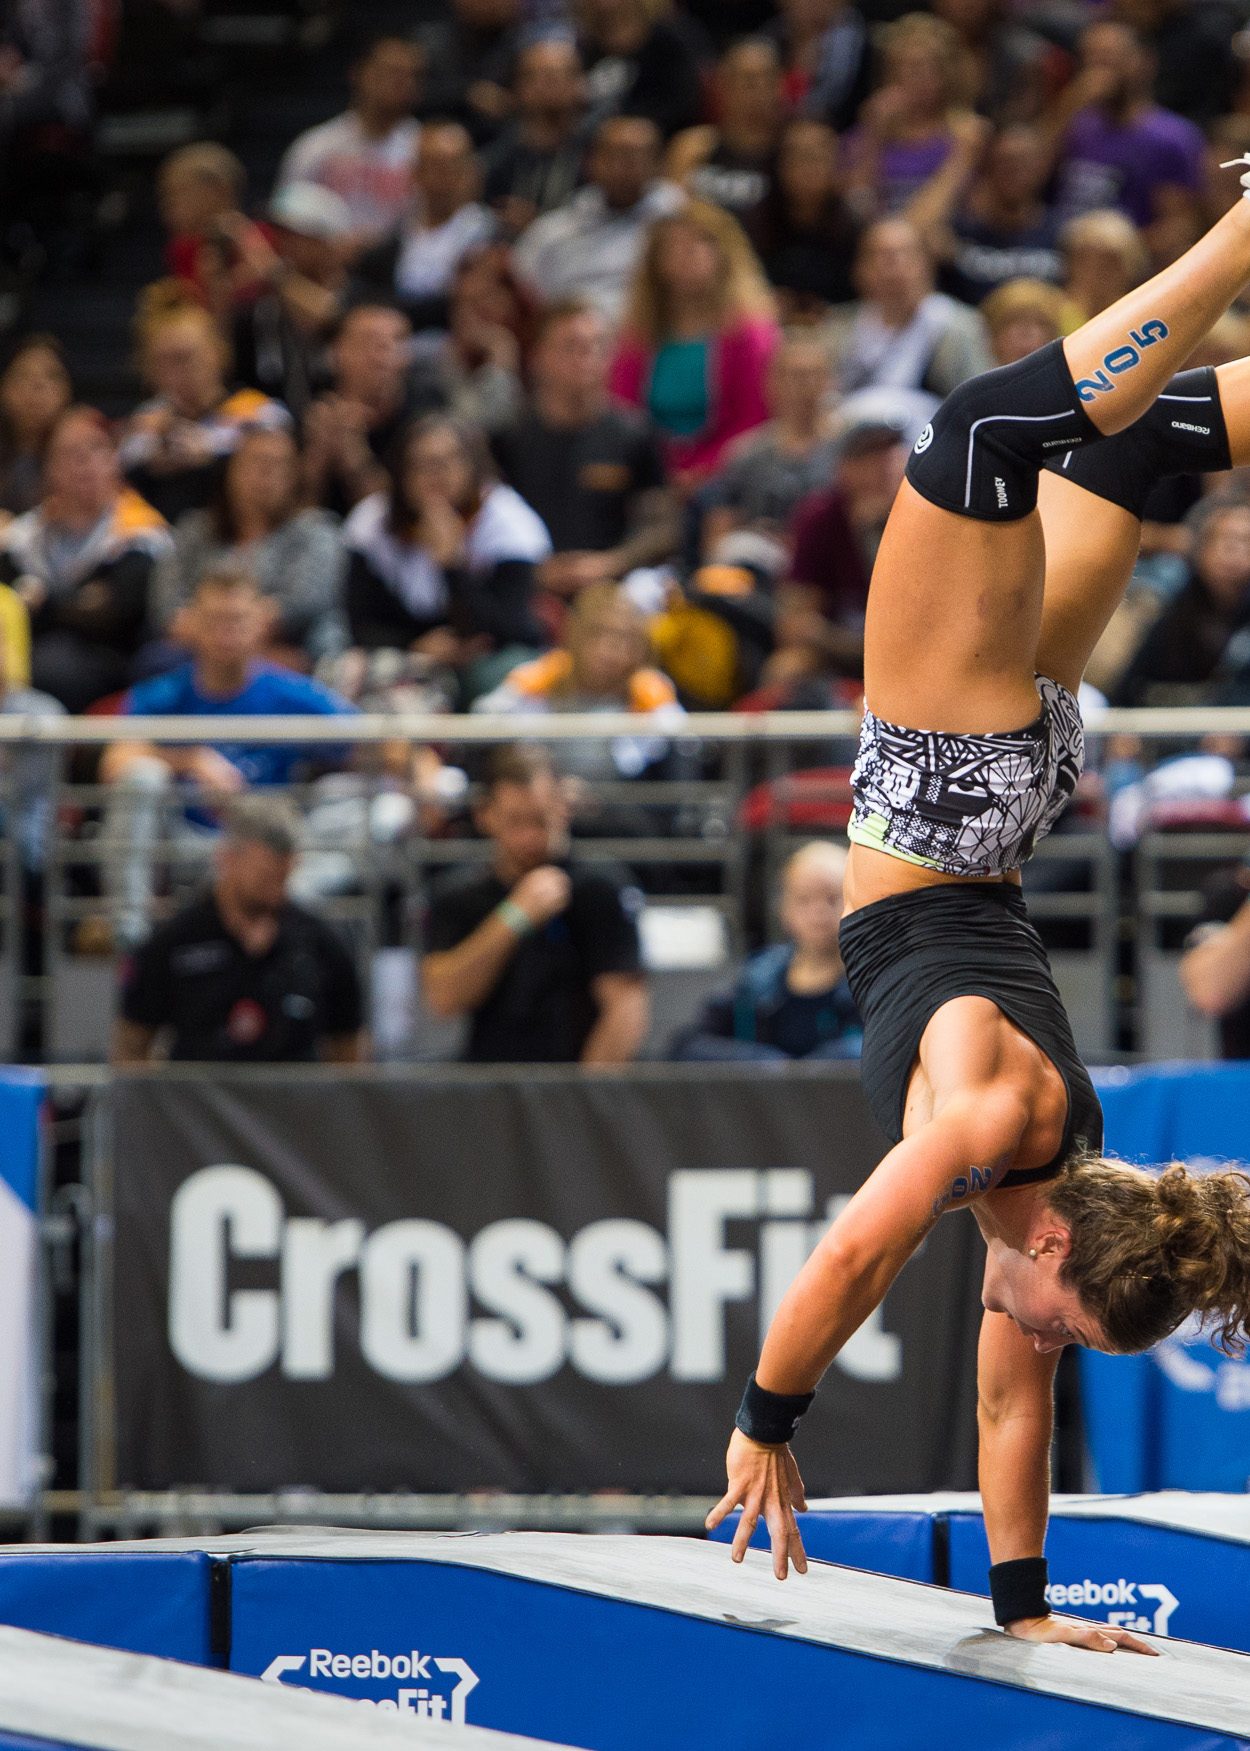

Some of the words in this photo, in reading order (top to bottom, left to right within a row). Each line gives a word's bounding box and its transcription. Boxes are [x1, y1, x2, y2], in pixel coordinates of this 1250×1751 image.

[1075, 319, 1169, 403] 205
[994, 476, 1009, 509] TOOMEY
[1044, 1578, 1138, 1606] eebok
[310, 1648, 432, 1679] Reebok
